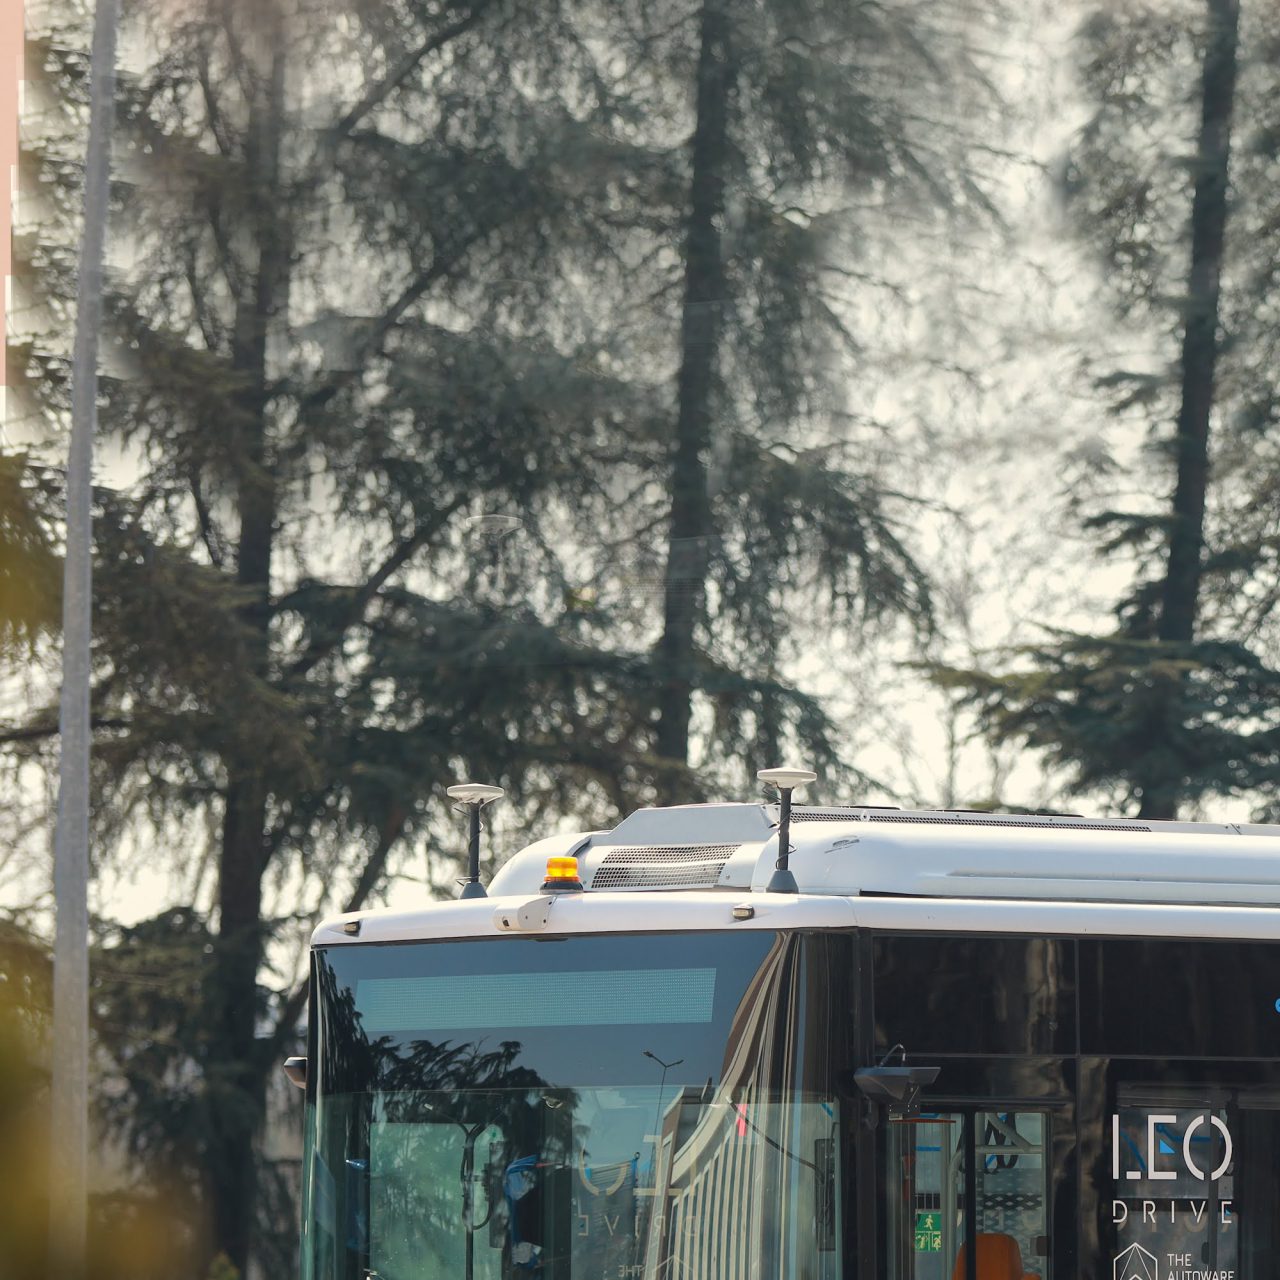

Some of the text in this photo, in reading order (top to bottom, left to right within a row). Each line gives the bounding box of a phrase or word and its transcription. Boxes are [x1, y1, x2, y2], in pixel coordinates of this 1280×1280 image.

[1112, 1114, 1233, 1181] LEO
[1112, 1200, 1232, 1224] DRIVE
[1167, 1253, 1192, 1267] THE
